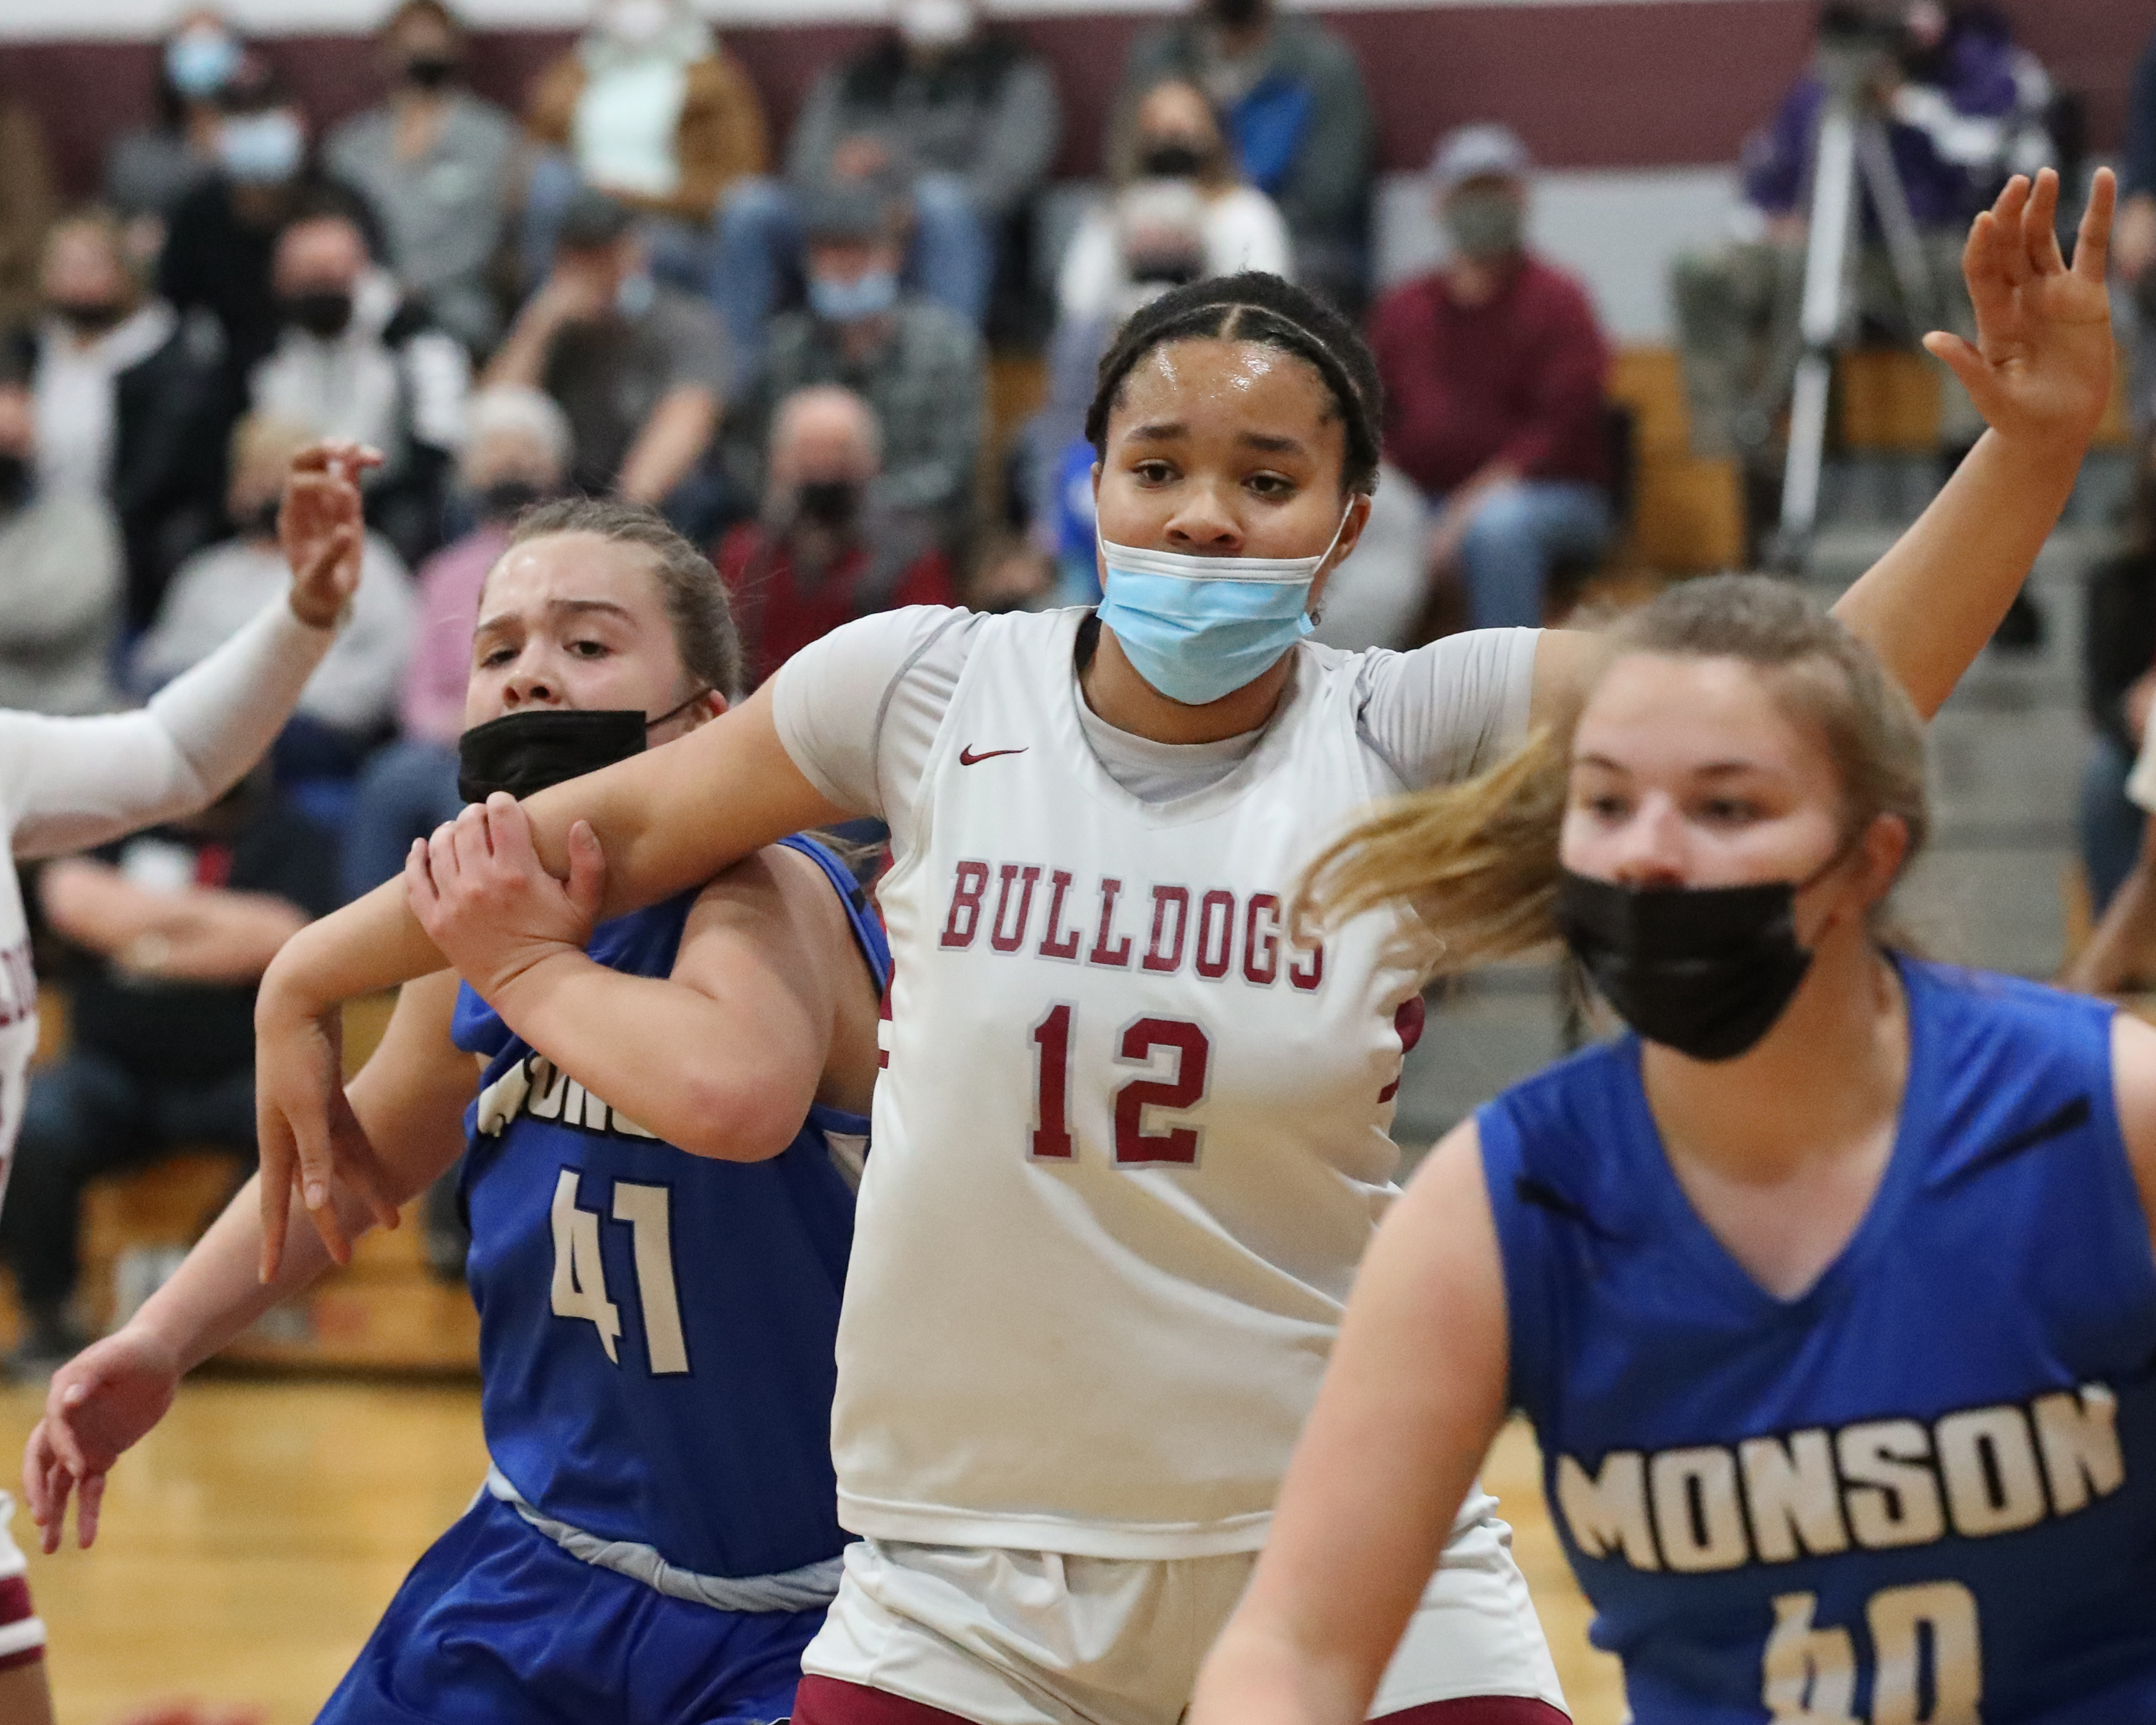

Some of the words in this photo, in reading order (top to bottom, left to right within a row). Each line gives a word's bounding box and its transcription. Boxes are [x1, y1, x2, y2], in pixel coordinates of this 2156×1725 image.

[937, 858, 1326, 994] BULLDOGS
[1027, 999, 1215, 1169] 12
[550, 1165, 691, 1376] 41
[1555, 1381, 2126, 1573] MONSON
